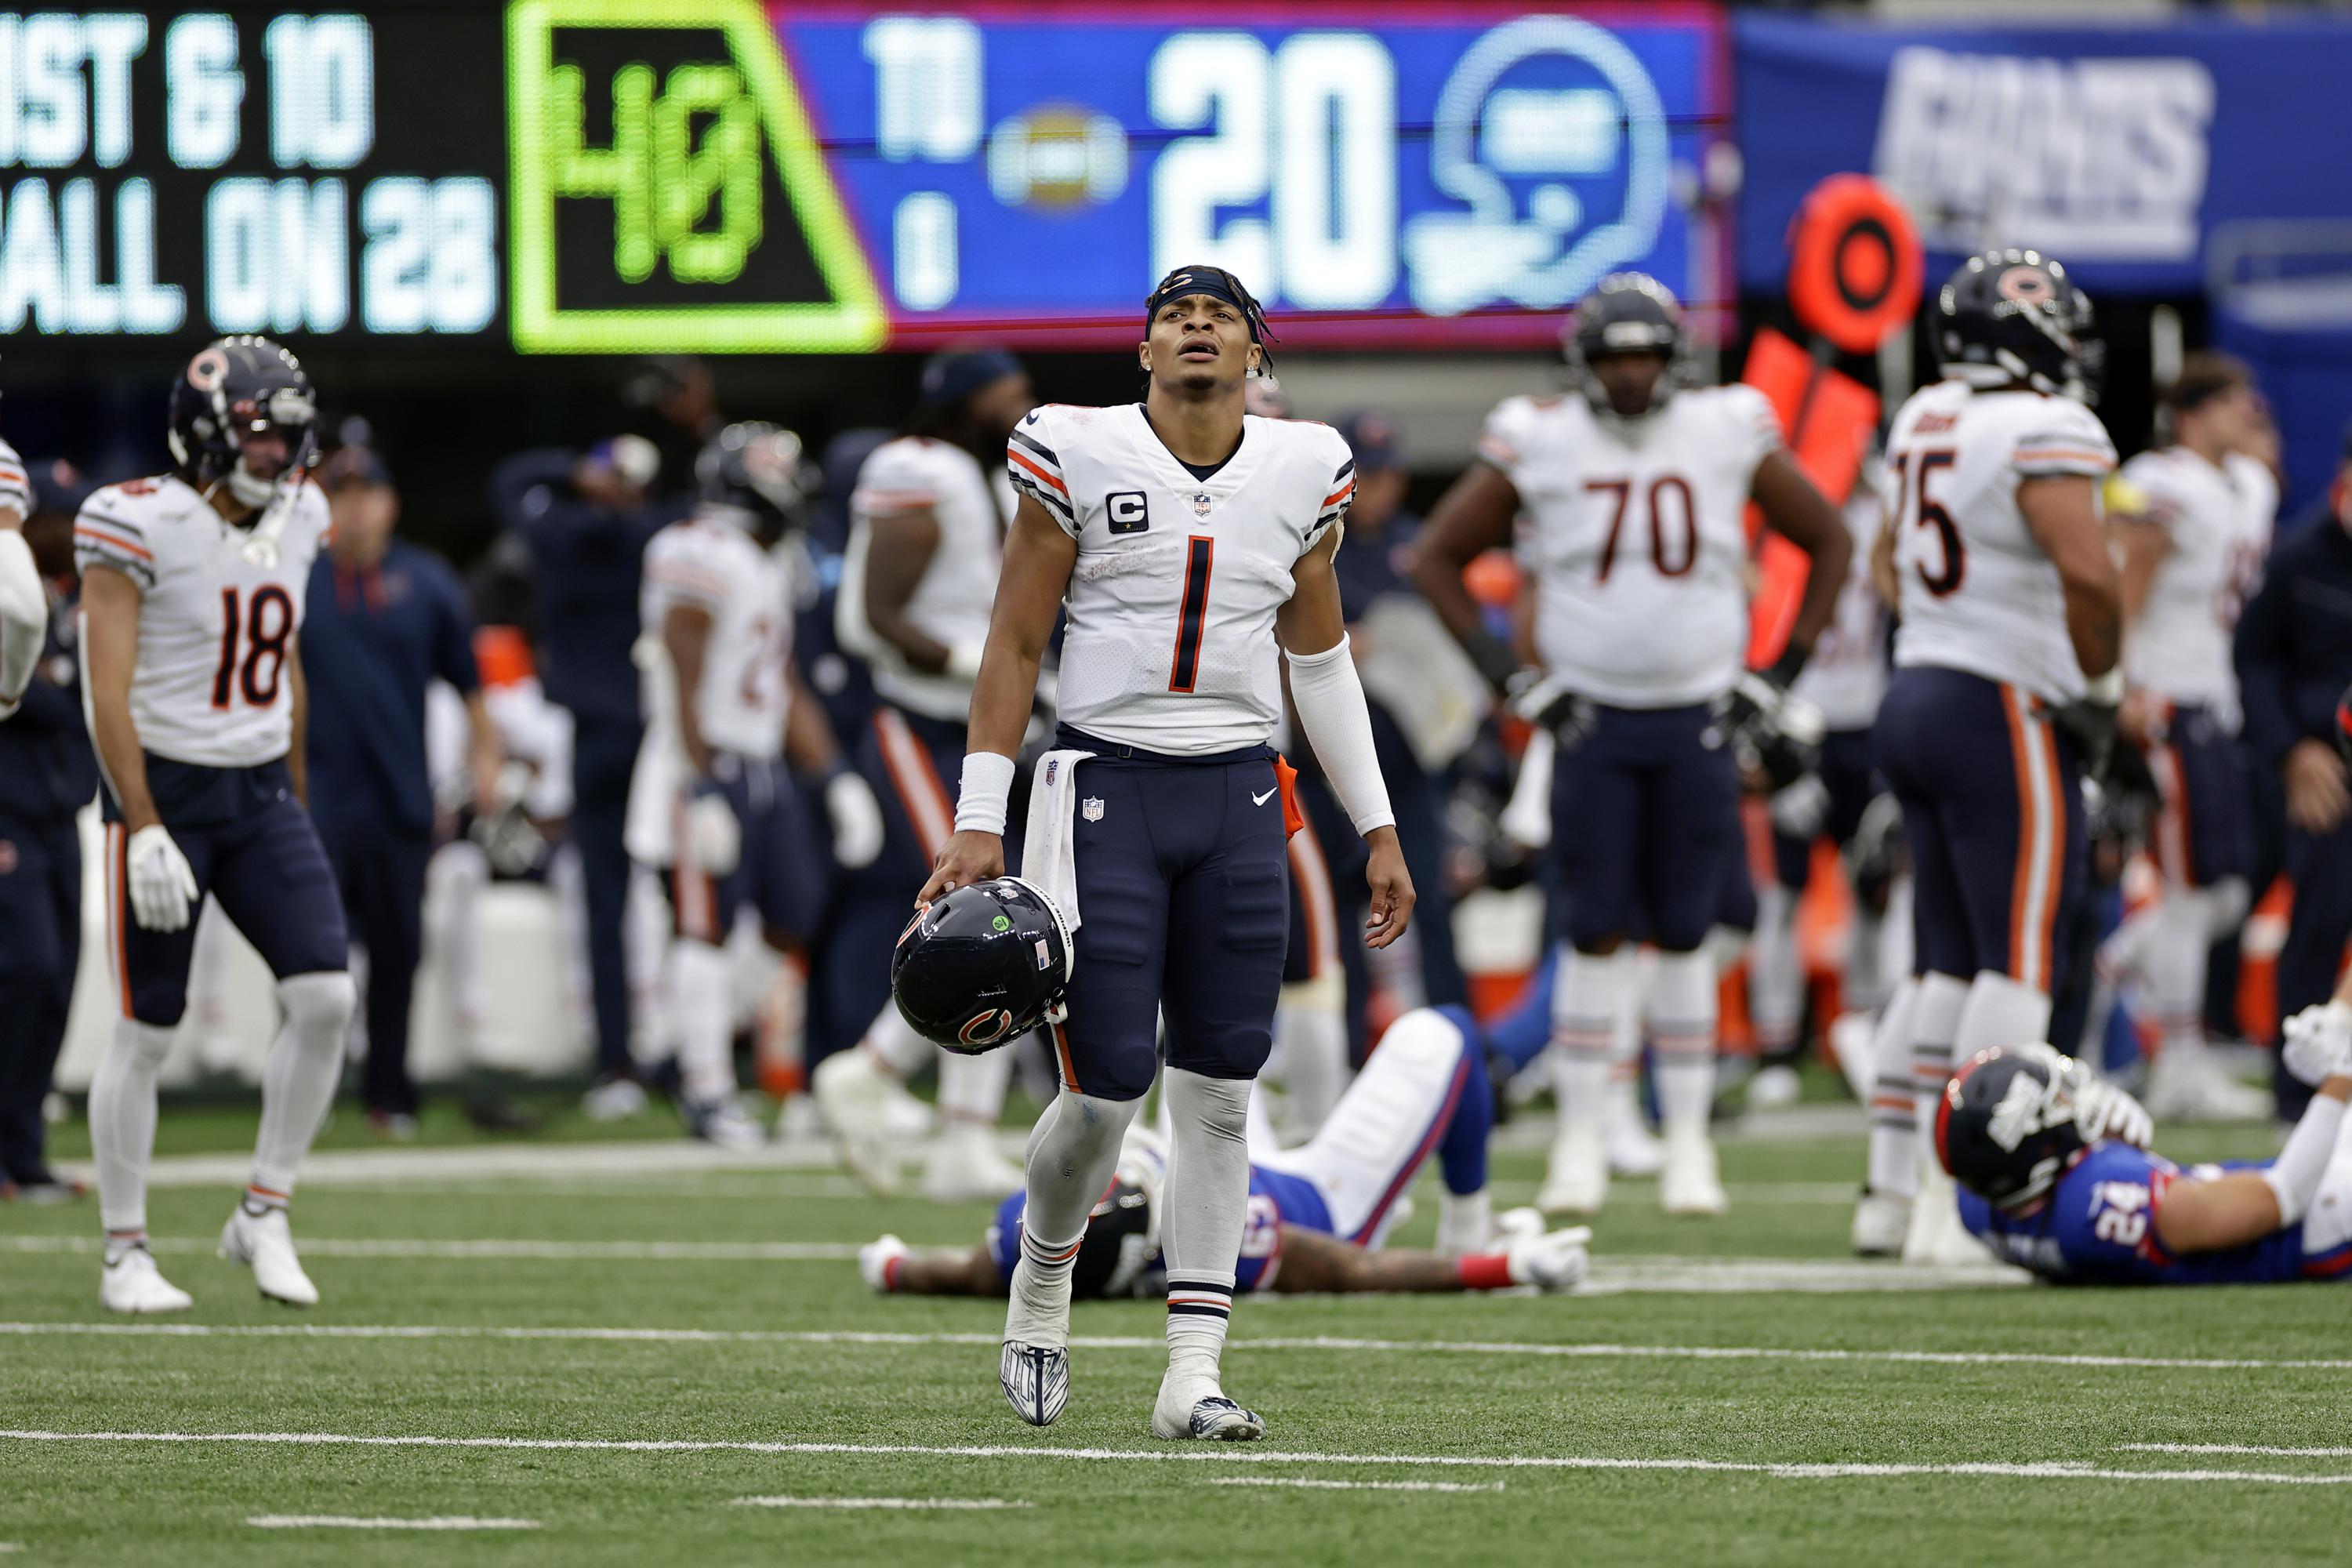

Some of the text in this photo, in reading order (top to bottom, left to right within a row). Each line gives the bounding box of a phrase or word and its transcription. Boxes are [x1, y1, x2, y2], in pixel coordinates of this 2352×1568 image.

[263, 14, 374, 169] 10
[549, 63, 764, 284] 40
[1148, 30, 1399, 309] 20
[0, 177, 498, 334] ALL ON 28
[1110, 494, 1145, 523] C
[1585, 475, 1697, 584] 70
[212, 584, 292, 711] 18
[1168, 535, 1214, 693] 1
[2094, 1181, 2151, 1246] 24
